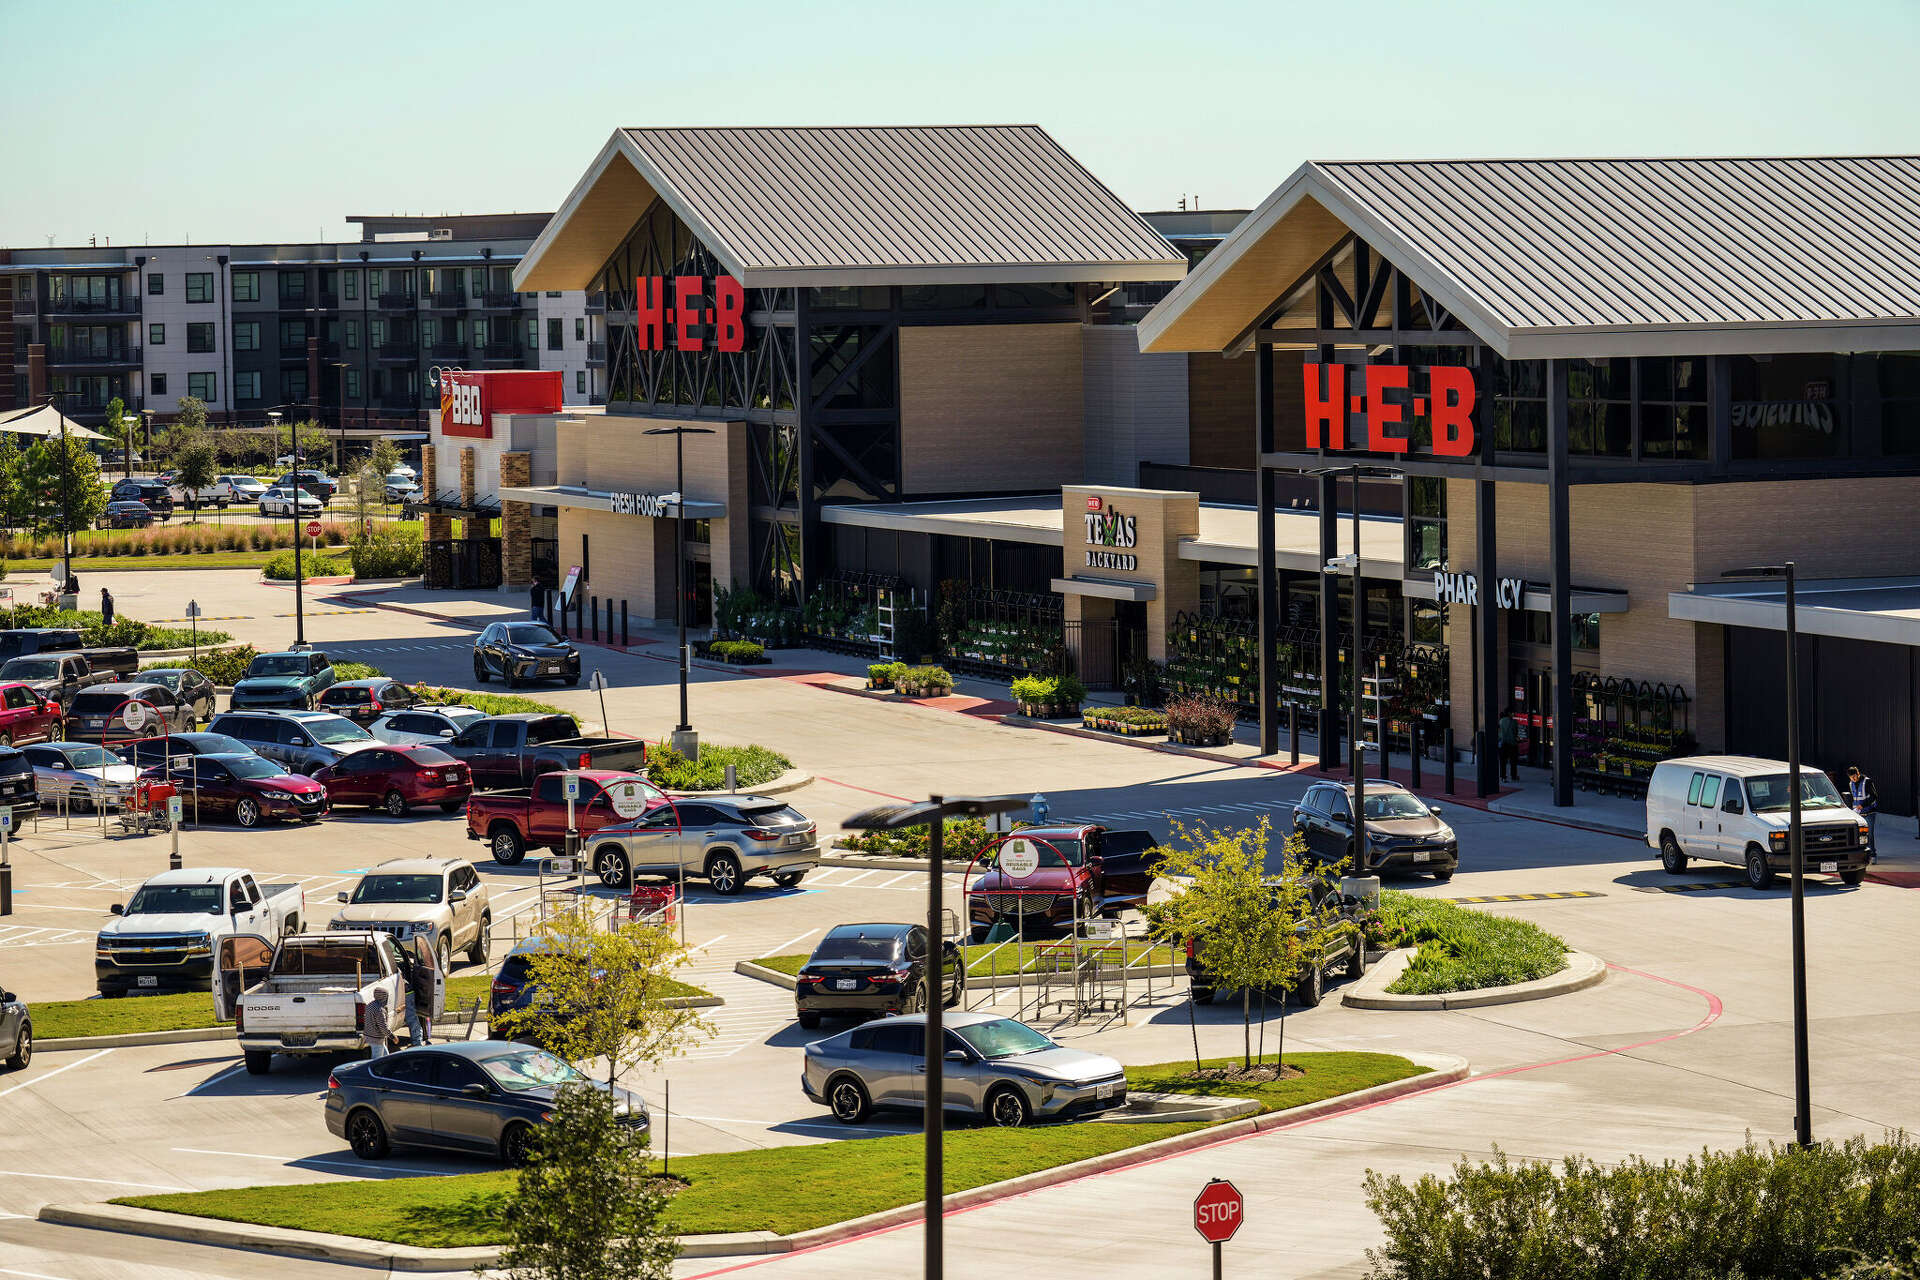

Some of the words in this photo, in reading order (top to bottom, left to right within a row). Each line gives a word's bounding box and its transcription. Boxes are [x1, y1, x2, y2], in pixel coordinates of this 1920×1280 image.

[452, 384, 483, 426] BBQ
[610, 492, 635, 515] FRESH
[1085, 509, 1136, 548] TEXAS
[1086, 551, 1135, 571] BACKYARD
[1434, 571, 1522, 610] PHARCY
[1199, 1200, 1239, 1224] STOP
